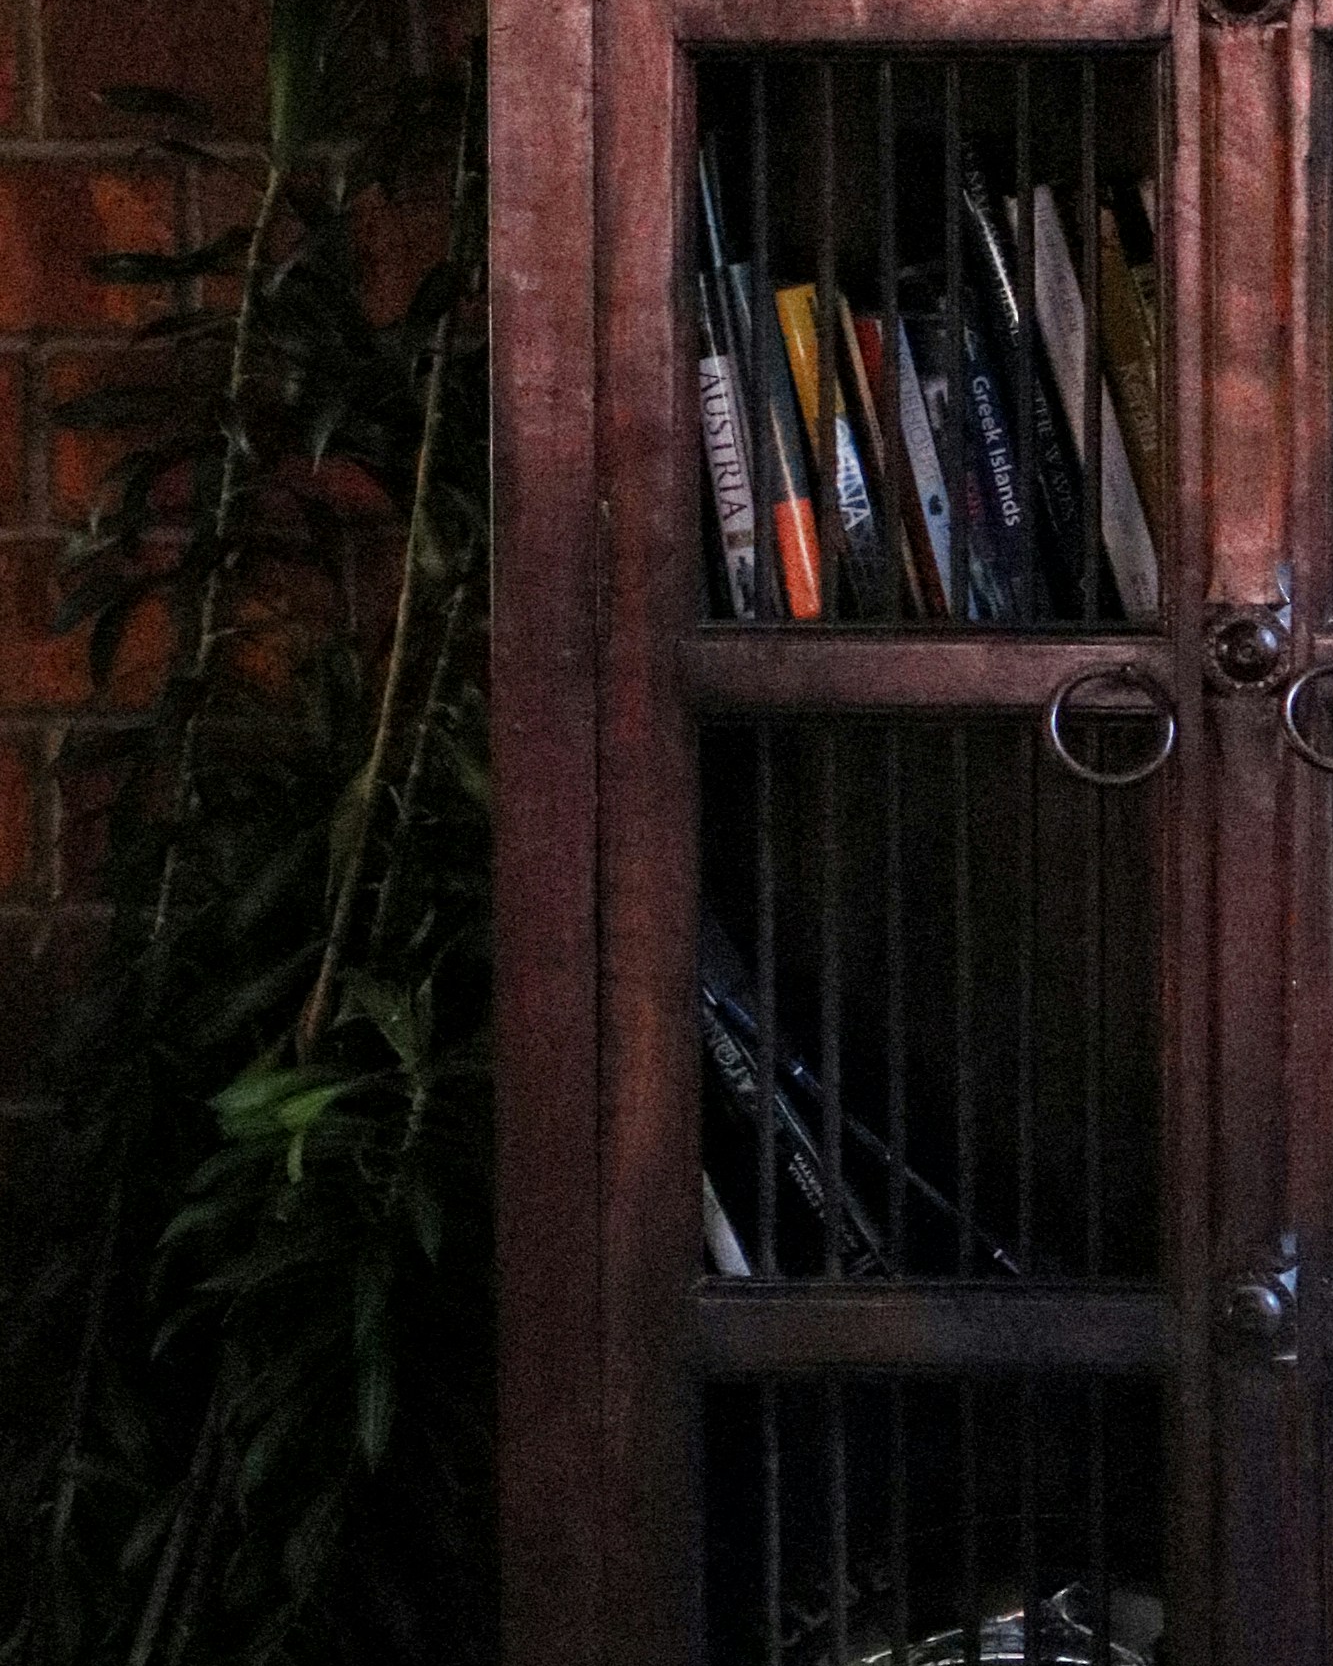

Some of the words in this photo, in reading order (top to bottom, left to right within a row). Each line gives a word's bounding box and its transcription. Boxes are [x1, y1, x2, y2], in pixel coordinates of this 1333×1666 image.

[699, 372, 747, 520] AUSTRIA
[972, 375, 1004, 444] Greek
[989, 447, 1022, 527] Islands
